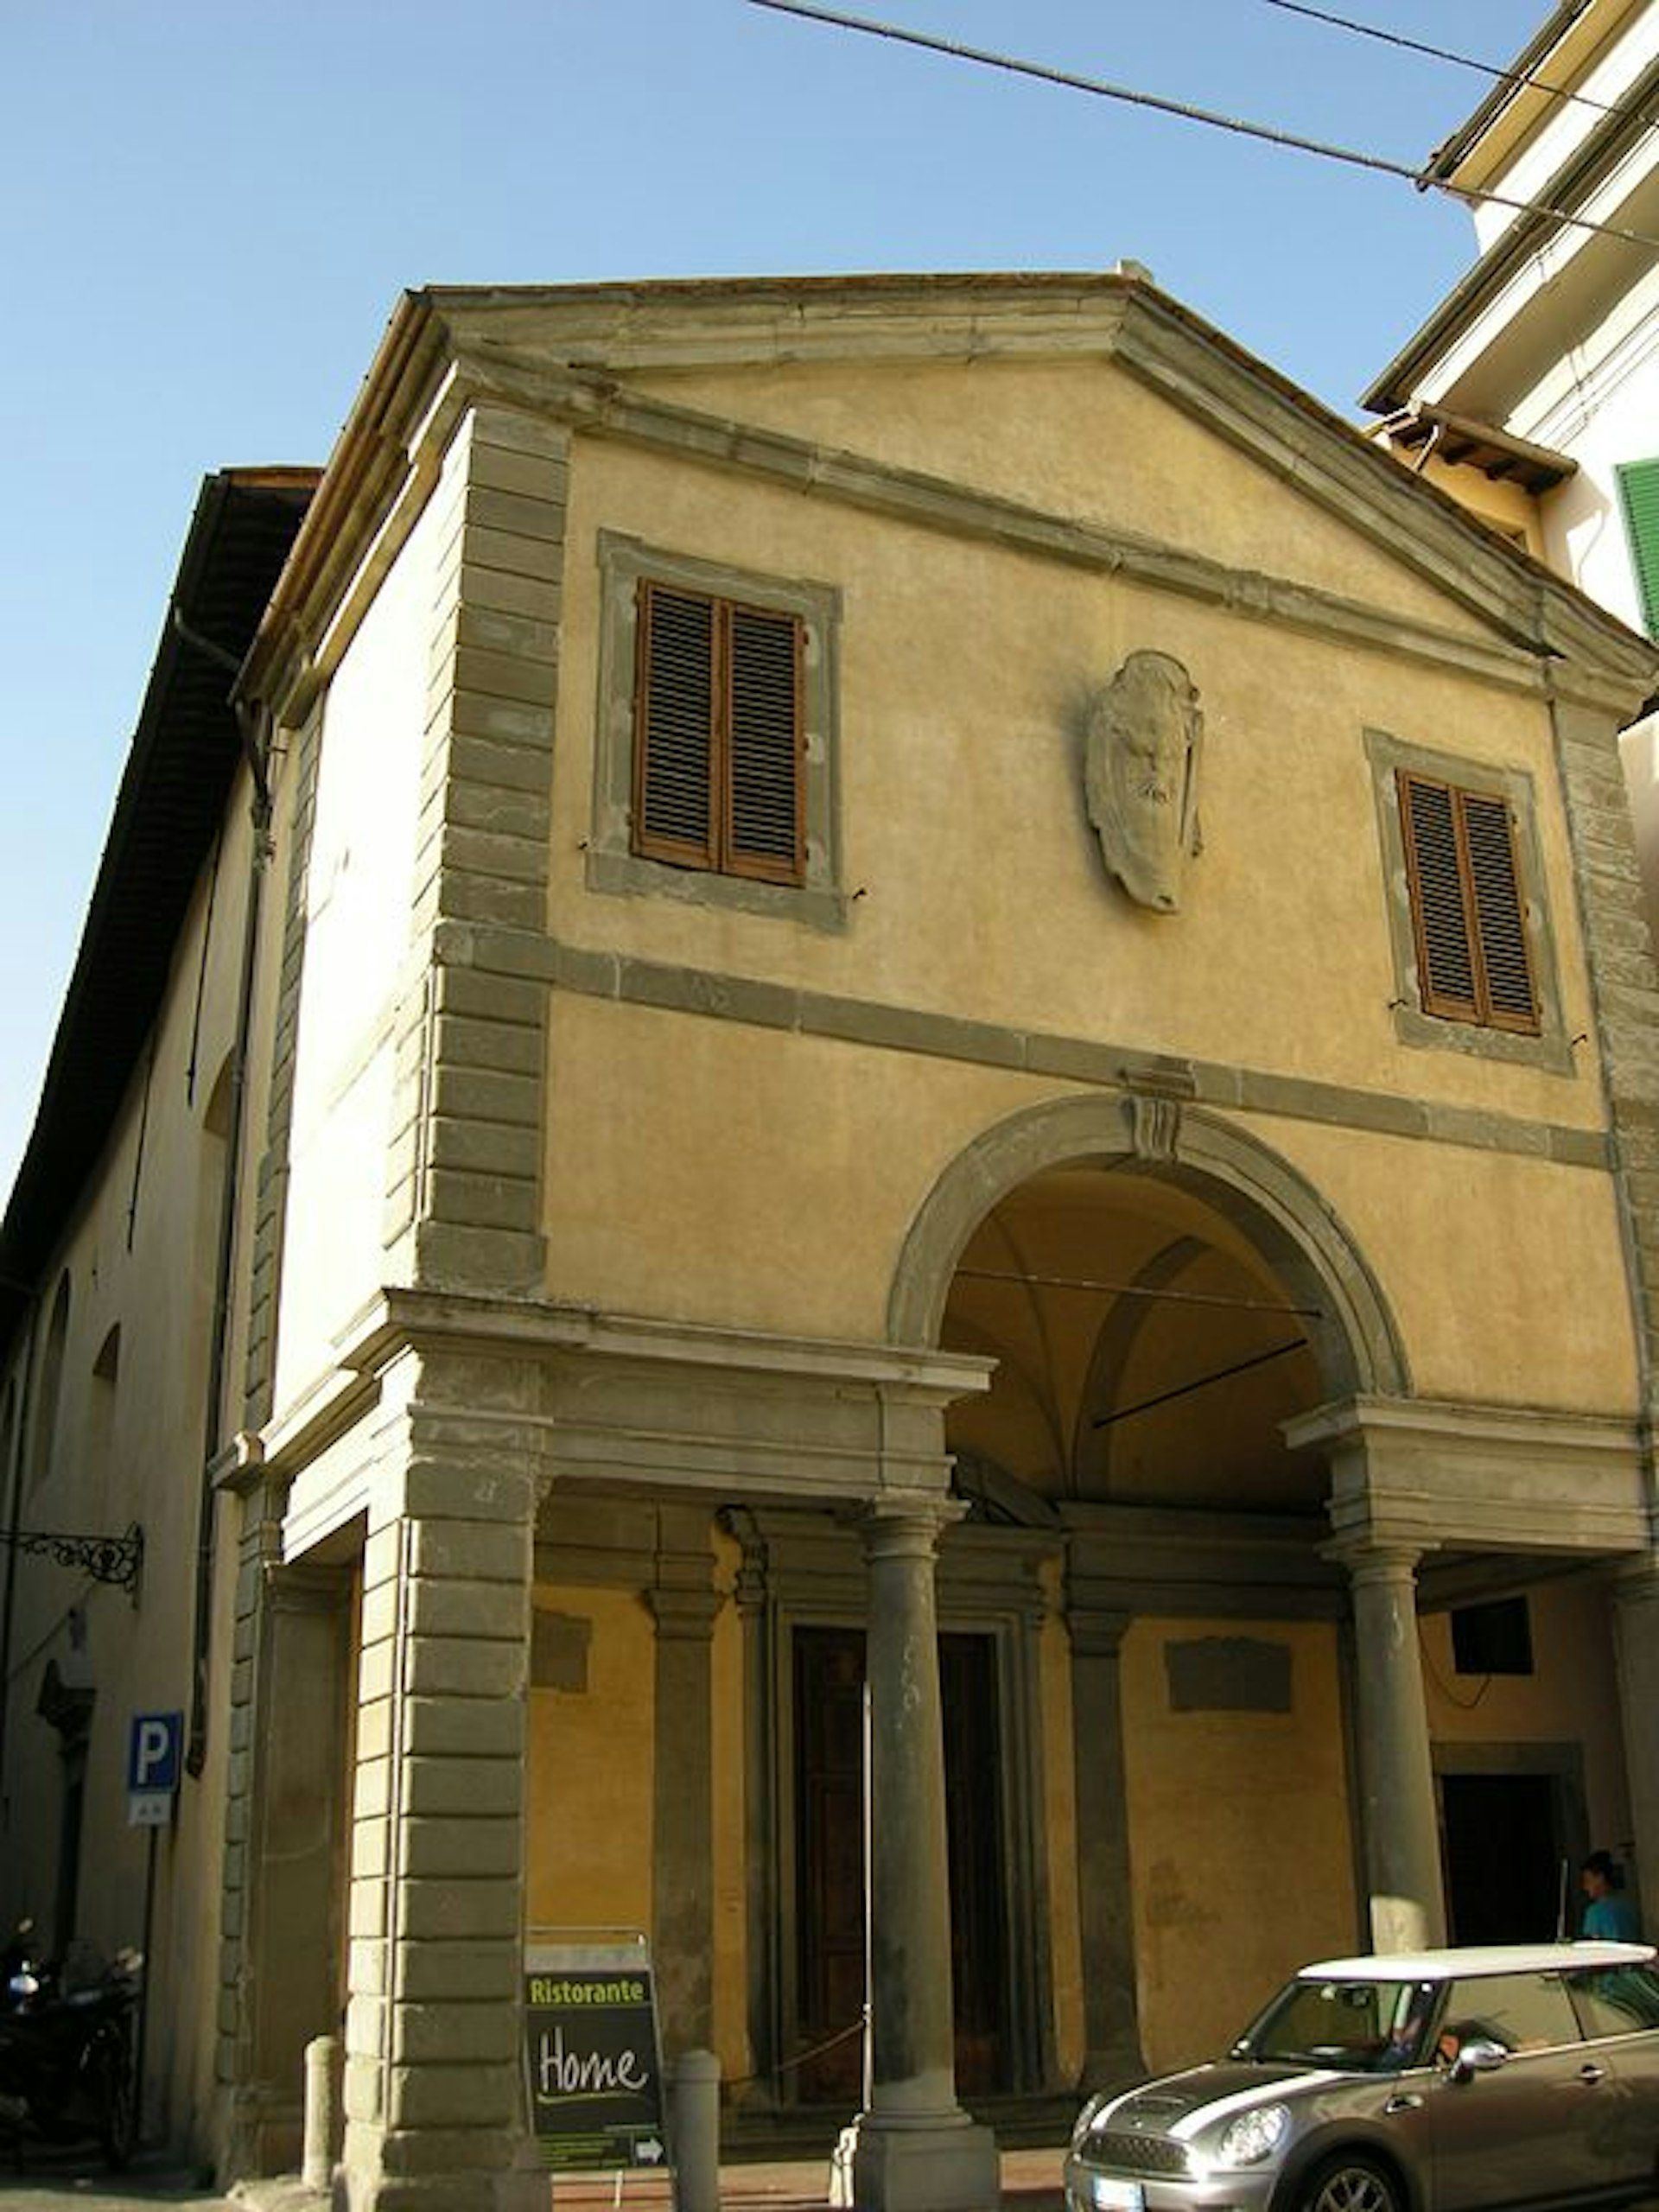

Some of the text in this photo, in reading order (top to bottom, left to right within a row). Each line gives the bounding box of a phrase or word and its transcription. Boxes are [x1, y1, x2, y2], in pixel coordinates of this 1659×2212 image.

[137, 1720, 169, 1784] P
[530, 1978, 645, 2004] Ristorante
[539, 2026, 649, 2092] Home
